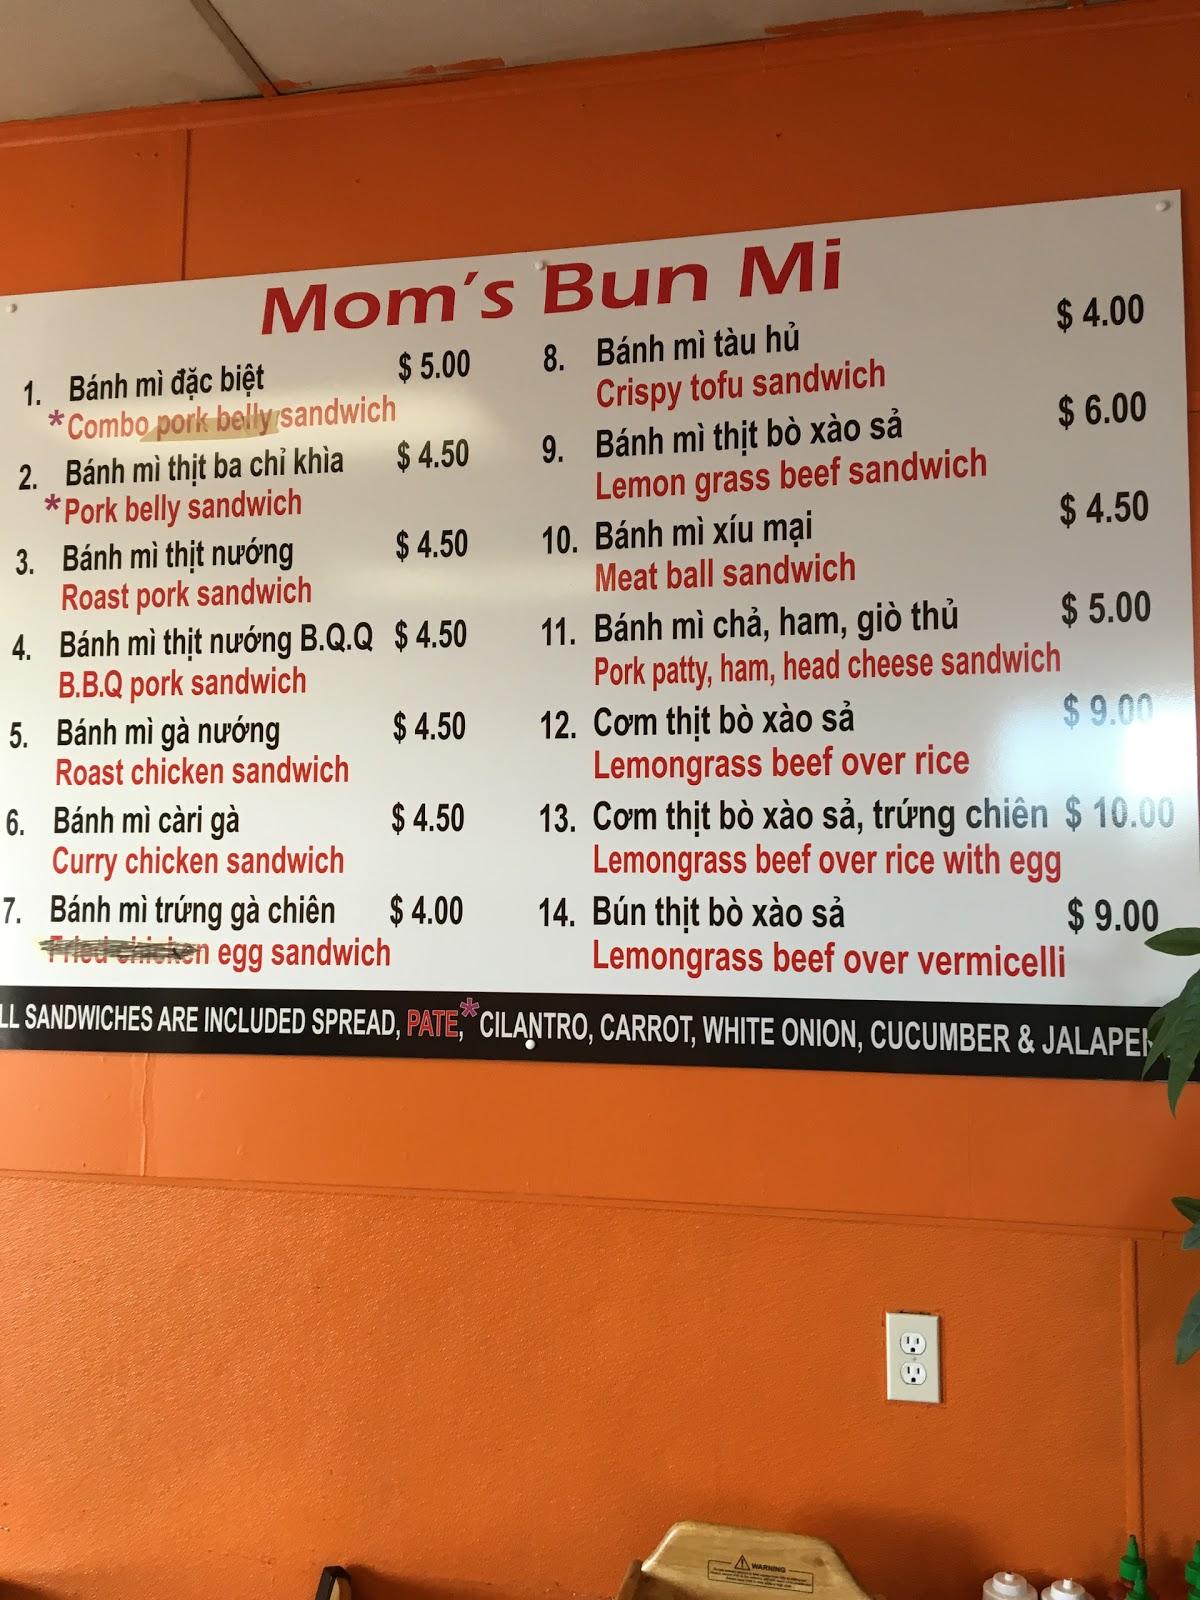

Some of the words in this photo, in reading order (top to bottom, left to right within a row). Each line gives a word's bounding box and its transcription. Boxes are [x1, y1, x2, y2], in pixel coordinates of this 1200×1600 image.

[260, 272, 515, 335] Mom's
[542, 260, 709, 316] Bun
[738, 236, 843, 299] Mi
[1082, 293, 1145, 328] 4.00
[597, 333, 665, 367] Bánh
[673, 329, 705, 361] mì
[713, 326, 756, 358] tàu
[766, 321, 799, 354] hủ
[70, 373, 128, 402] Bánh
[136, 370, 163, 398] mì
[171, 368, 213, 400] đặc
[220, 363, 264, 396] biệt
[420, 348, 471, 380] 5.00
[595, 377, 684, 413] Crispy
[689, 368, 745, 402] tofu
[751, 356, 886, 398] sandwich
[67, 411, 149, 441] Combo
[157, 407, 208, 443] pork
[217, 403, 272, 437] belly
[280, 396, 395, 428] sandwich
[1084, 390, 1147, 426] 6.00
[596, 425, 664, 459] Bánh
[673, 422, 705, 454] mì
[712, 419, 759, 457] thịt
[767, 415, 802, 448] bò
[809, 412, 861, 445] xào
[869, 407, 903, 441] sả
[66, 459, 124, 487] Bánh
[132, 454, 161, 483] mì
[167, 452, 207, 487] thịt
[213, 451, 242, 479] ba
[249, 447, 287, 478] chỉ
[293, 445, 344, 476] khìa
[417, 438, 470, 469] 4.50
[595, 471, 687, 502] Lemon
[694, 467, 772, 504] grass
[778, 454, 842, 491] beef
[847, 447, 988, 486] sandwich
[63, 495, 119, 528] Pork
[123, 492, 182, 529] belly
[186, 486, 303, 521] sandwich
[1086, 489, 1149, 524] 4.50
[416, 528, 468, 559] 4.50
[595, 518, 663, 551] Bánh
[672, 515, 704, 547] mì
[712, 513, 753, 545] xíu
[763, 509, 812, 548] mại
[62, 542, 122, 572] Bánh
[130, 540, 158, 570] mì
[165, 539, 205, 575] thịt
[212, 536, 294, 572] nướng
[594, 560, 658, 593] Meat
[665, 558, 714, 591] ball
[721, 550, 857, 589] sandwich
[60, 581, 130, 612] Roast
[134, 577, 190, 615] pork
[195, 575, 314, 608] sandwich
[1088, 590, 1151, 624] 5.00
[415, 618, 467, 649] 4.50
[594, 611, 663, 643] Bánh
[672, 609, 704, 640] mì
[713, 606, 770, 643] chả,
[779, 605, 847, 640] ham,
[857, 600, 902, 642] giò
[910, 597, 958, 632] thủ
[59, 629, 120, 658] Bánh
[127, 627, 156, 656] mì
[162, 626, 203, 662] thịt
[210, 624, 292, 660] nướng
[300, 621, 374, 653] B.Q.Q
[58, 667, 124, 700] B.B.Q
[129, 667, 184, 705] pork
[190, 665, 308, 698] sandwich
[593, 655, 645, 687] Pork
[651, 655, 713, 692] patty,
[719, 654, 775, 684] ham,
[782, 650, 841, 682] head
[847, 647, 934, 680] cheese
[940, 642, 1061, 677] sandwich
[414, 710, 466, 741] 4.50
[593, 706, 657, 737] Cơm
[665, 704, 711, 743] thịt
[719, 703, 754, 735] bò
[762, 702, 813, 734] xào
[821, 699, 855, 733] sả
[1089, 692, 1154, 727] 9.00
[56, 717, 117, 746] Bánh
[125, 716, 153, 745] mì
[161, 715, 190, 752] gà
[198, 714, 280, 751] nướng
[55, 757, 125, 786] Roast
[130, 756, 225, 786] chicken
[231, 753, 350, 785] sandwich
[593, 750, 763, 787] Lemongrass
[771, 744, 833, 778] beef
[840, 751, 907, 777] over
[914, 743, 970, 776] rice
[53, 805, 114, 834] Bánh
[122, 804, 151, 834] mì
[158, 804, 203, 834] càri
[210, 803, 240, 841] gà
[412, 802, 465, 833] 4.50
[592, 800, 657, 831] Cơm
[665, 799, 711, 838] thịt
[719, 798, 754, 831] bò
[762, 798, 814, 830] xào
[822, 797, 863, 836] sả,
[872, 797, 955, 838] trứng
[964, 795, 1049, 831] chiên
[1093, 795, 1175, 833] 10.00
[52, 845, 118, 881] Curry
[124, 846, 219, 875] chicken
[226, 845, 345, 875] sandwich
[593, 844, 748, 882] Lemongrass
[755, 842, 813, 875] beef
[817, 849, 878, 875] over
[884, 843, 936, 876] rice
[943, 843, 1001, 875] with
[1009, 850, 1061, 884] egg
[50, 894, 111, 923] Bánh
[119, 894, 147, 923] mì
[154, 894, 223, 932] trứng
[230, 894, 260, 932] gà
[268, 894, 335, 924] chiên
[411, 895, 464, 926] 4.00
[593, 895, 646, 926] Bún
[654, 895, 700, 934] thịt
[708, 895, 744, 927] bò
[751, 895, 803, 928] xào
[811, 895, 845, 929] sả
[1094, 898, 1159, 933] 9.00
[217, 943, 264, 974] egg
[271, 936, 391, 968] sandwich
[592, 938, 764, 980] Lemongrass
[772, 941, 836, 973] beef
[843, 949, 909, 975] over
[917, 944, 1065, 978] vermicelli
[24, 1003, 153, 1032] SANDWICHES
[156, 1006, 199, 1033] ARE
[204, 1006, 306, 1034] INCLUDED
[311, 1007, 401, 1041] SPREAD,
[480, 1011, 592, 1043] CILANTRO,
[600, 1013, 696, 1049] CARROT,
[702, 1015, 775, 1046] WHITE
[781, 1017, 863, 1054] ONION,
[870, 1020, 1011, 1053] CUCUMBER
[1017, 1024, 1036, 1054] &
